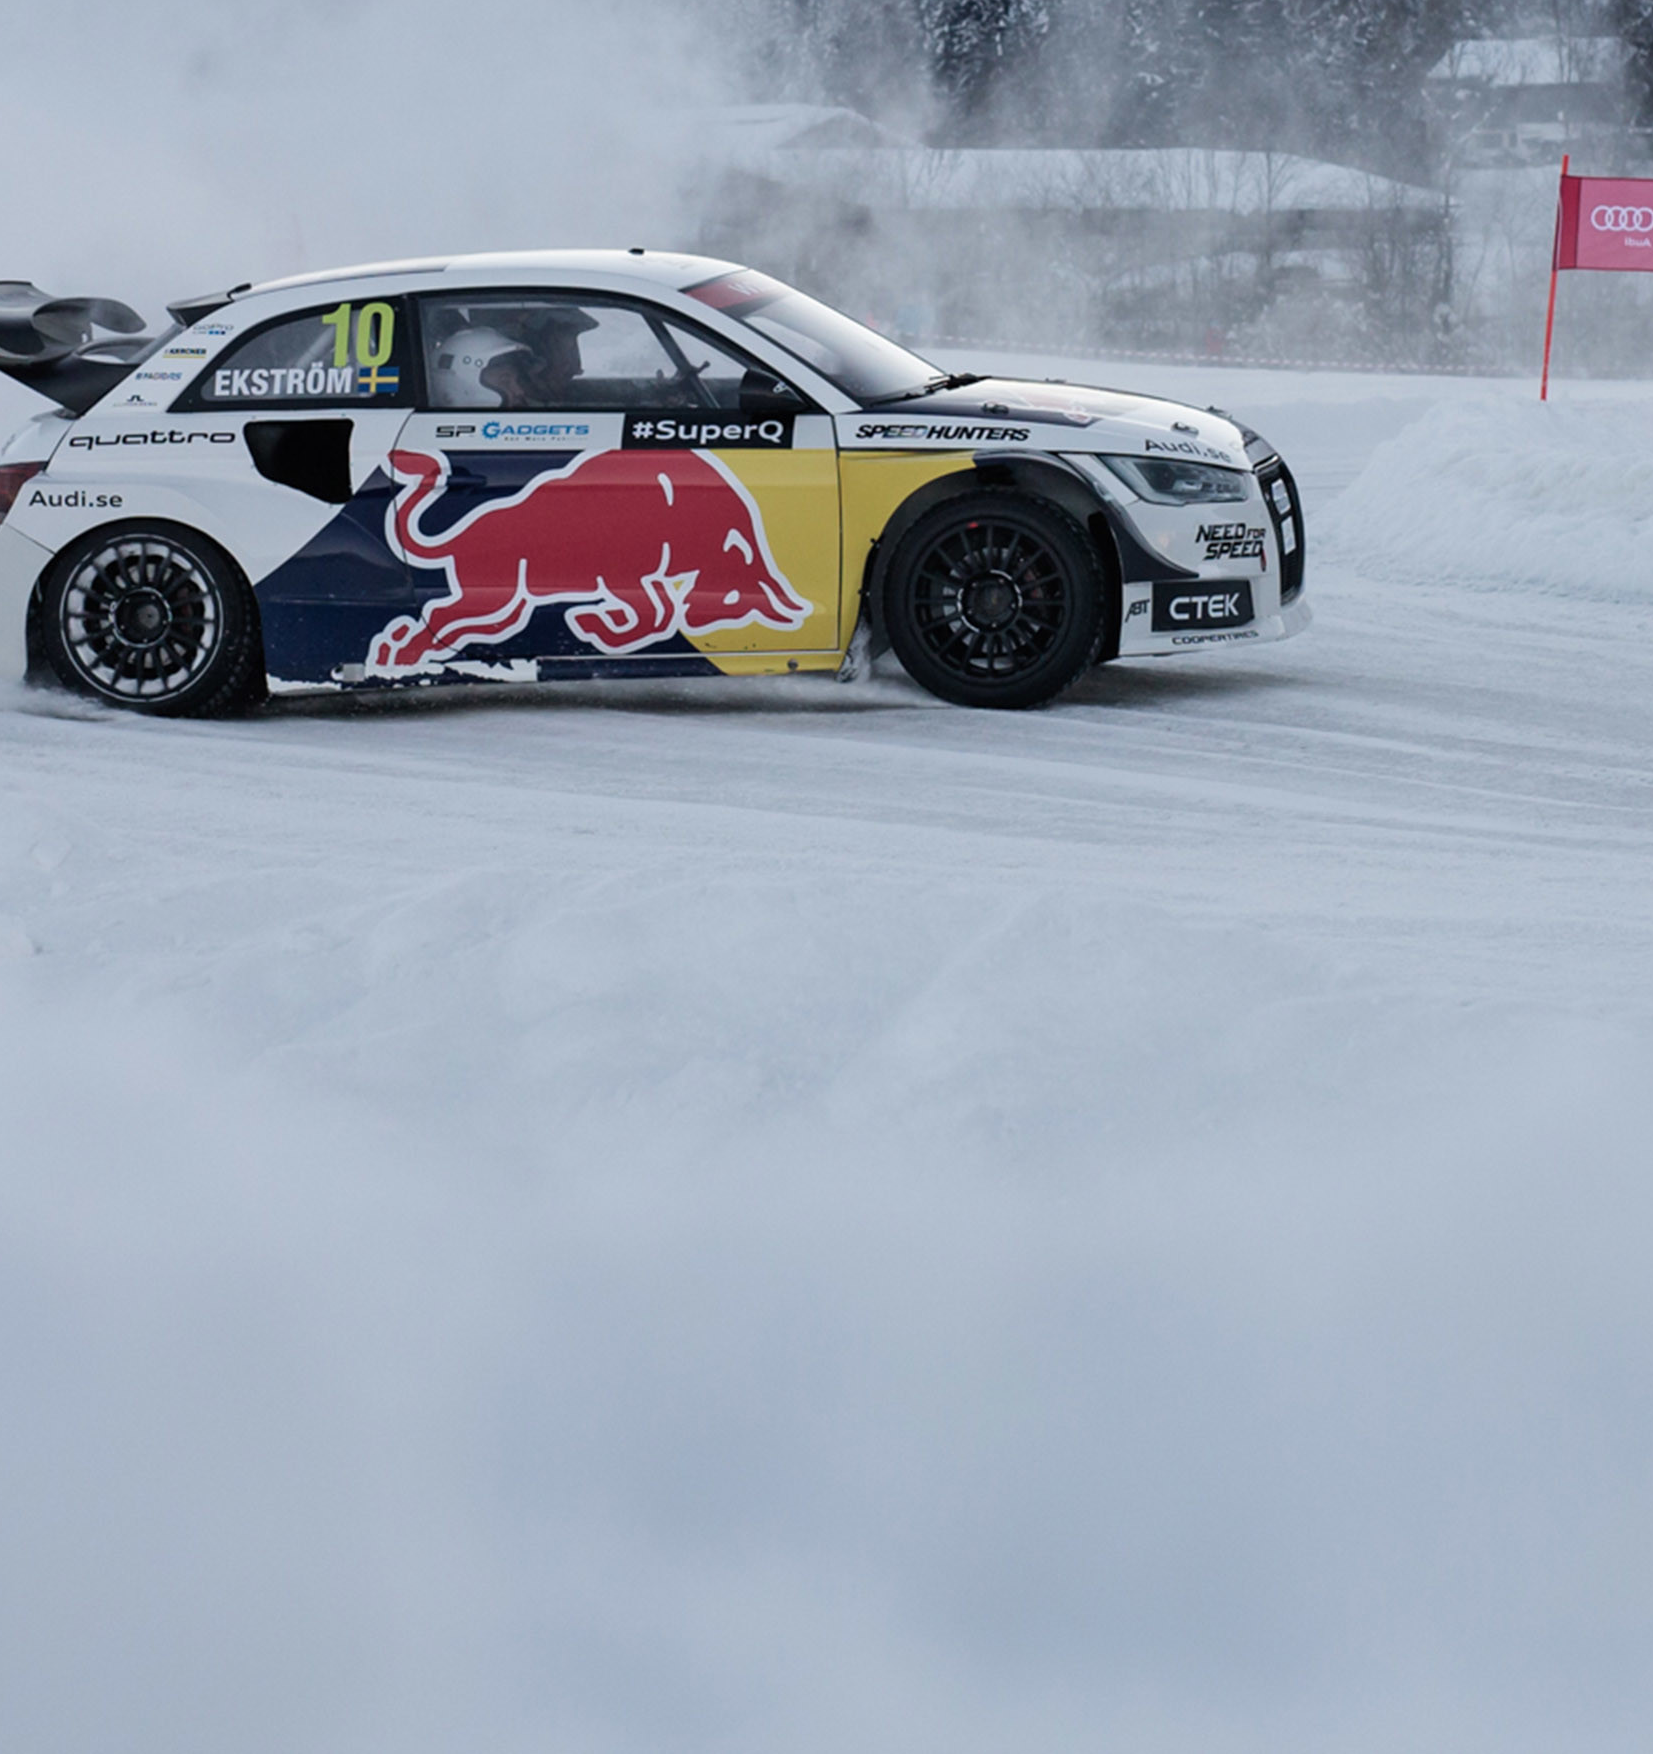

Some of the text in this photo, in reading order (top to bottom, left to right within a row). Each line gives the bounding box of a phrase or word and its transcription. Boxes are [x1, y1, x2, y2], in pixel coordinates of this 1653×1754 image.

[322, 302, 395, 367] 10
[214, 361, 354, 396] EKSTRÖM
[68, 429, 236, 450] quattro
[436, 421, 590, 439] SP GADGETS
[632, 419, 784, 445] #SuperQ
[1145, 438, 1232, 463] Audi.se
[28, 490, 124, 508] Audi.se
[1196, 523, 1266, 542] NEED FOR
[1203, 541, 1263, 560] SPEED
[1124, 599, 1150, 623] ABT
[1169, 593, 1240, 620] CTEK
